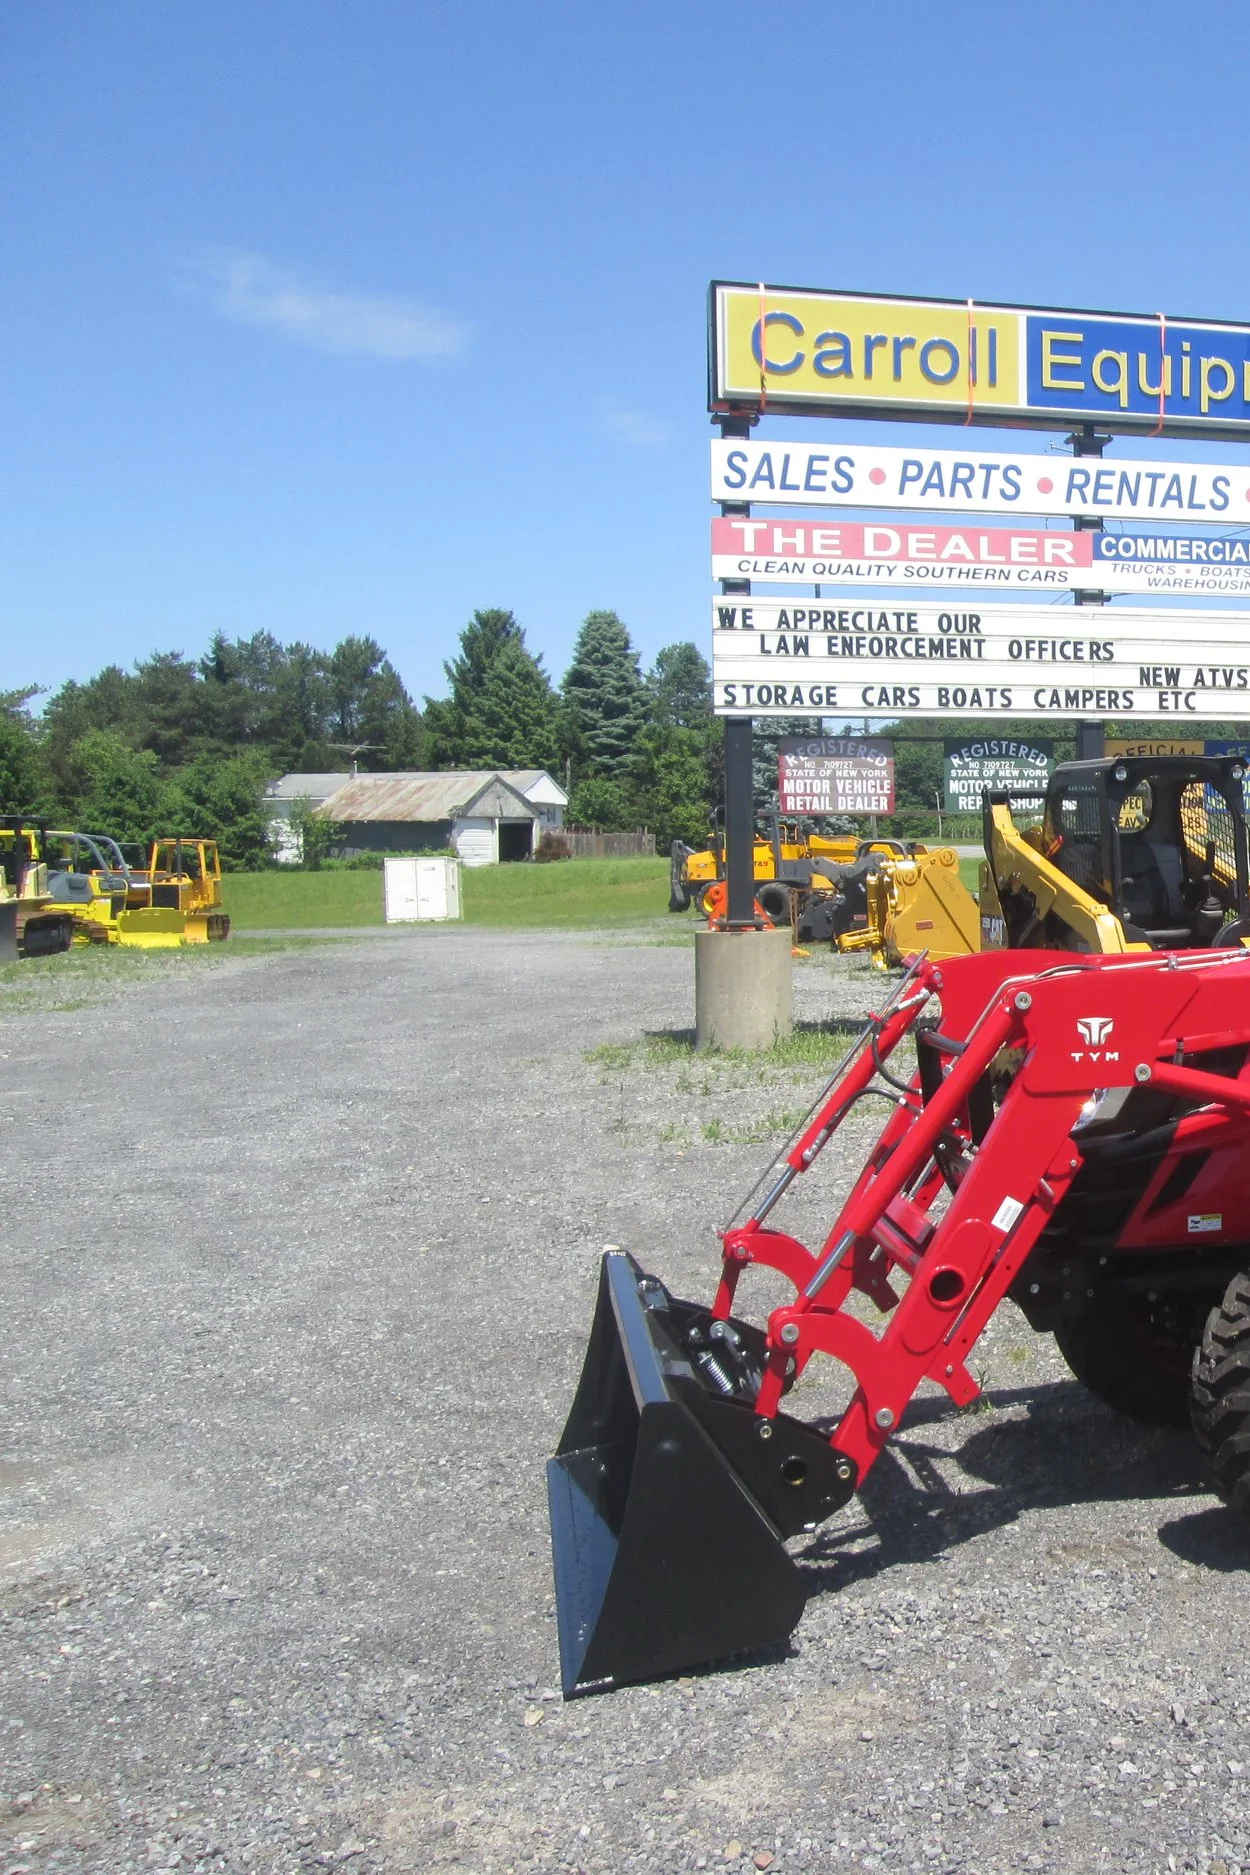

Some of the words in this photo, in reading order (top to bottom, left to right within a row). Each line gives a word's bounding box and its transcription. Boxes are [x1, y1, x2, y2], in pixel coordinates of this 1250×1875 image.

[751, 311, 997, 388] Carroll
[723, 451, 855, 493] SALES
[898, 459, 1022, 501] PARTS
[1065, 468, 1230, 511] RENTALS
[731, 521, 842, 555] THE
[863, 527, 1076, 565] DEALER
[737, 559, 806, 575] CLEAN
[812, 562, 897, 578] QUALITY
[903, 565, 1011, 581] SOUTHERN
[1017, 569, 1069, 584] CARS
[1111, 563, 1176, 576] TRUCKS
[718, 607, 754, 628] WE
[777, 609, 919, 633] APPRECIATE
[938, 613, 981, 634] OUR
[760, 634, 810, 656] LAW
[827, 635, 986, 659] ENFORCEMENT
[1008, 639, 1115, 662] OFFICERS
[1139, 666, 1181, 687] NEW
[1193, 668, 1249, 688] ATVS
[723, 684, 838, 706] STORAGE
[861, 686, 920, 707] CARS
[937, 687, 1012, 708] BOATS
[1034, 689, 1134, 710] CAMPERS
[1158, 691, 1196, 711] ETC
[785, 740, 888, 767] REGISTERED
[949, 740, 1048, 768] REGISTERED
[1113, 744, 1196, 756] FFICIA
[785, 769, 816, 777] STATE
[819, 769, 832, 777] OF
[836, 769, 858, 777] NEW
[950, 769, 979, 777] STATE
[982, 769, 995, 777] OF
[999, 769, 1019, 777] NEW
[1022, 769, 1048, 777] YORK
[983, 761, 1015, 769] 7109727
[783, 779, 830, 794] MOTOR
[836, 779, 891, 794] VEHICLE
[786, 796, 833, 810] RETAIL
[838, 796, 888, 810] DEALER
[1009, 798, 1044, 810] SHOP
[1071, 1052, 1119, 1062] TYM
